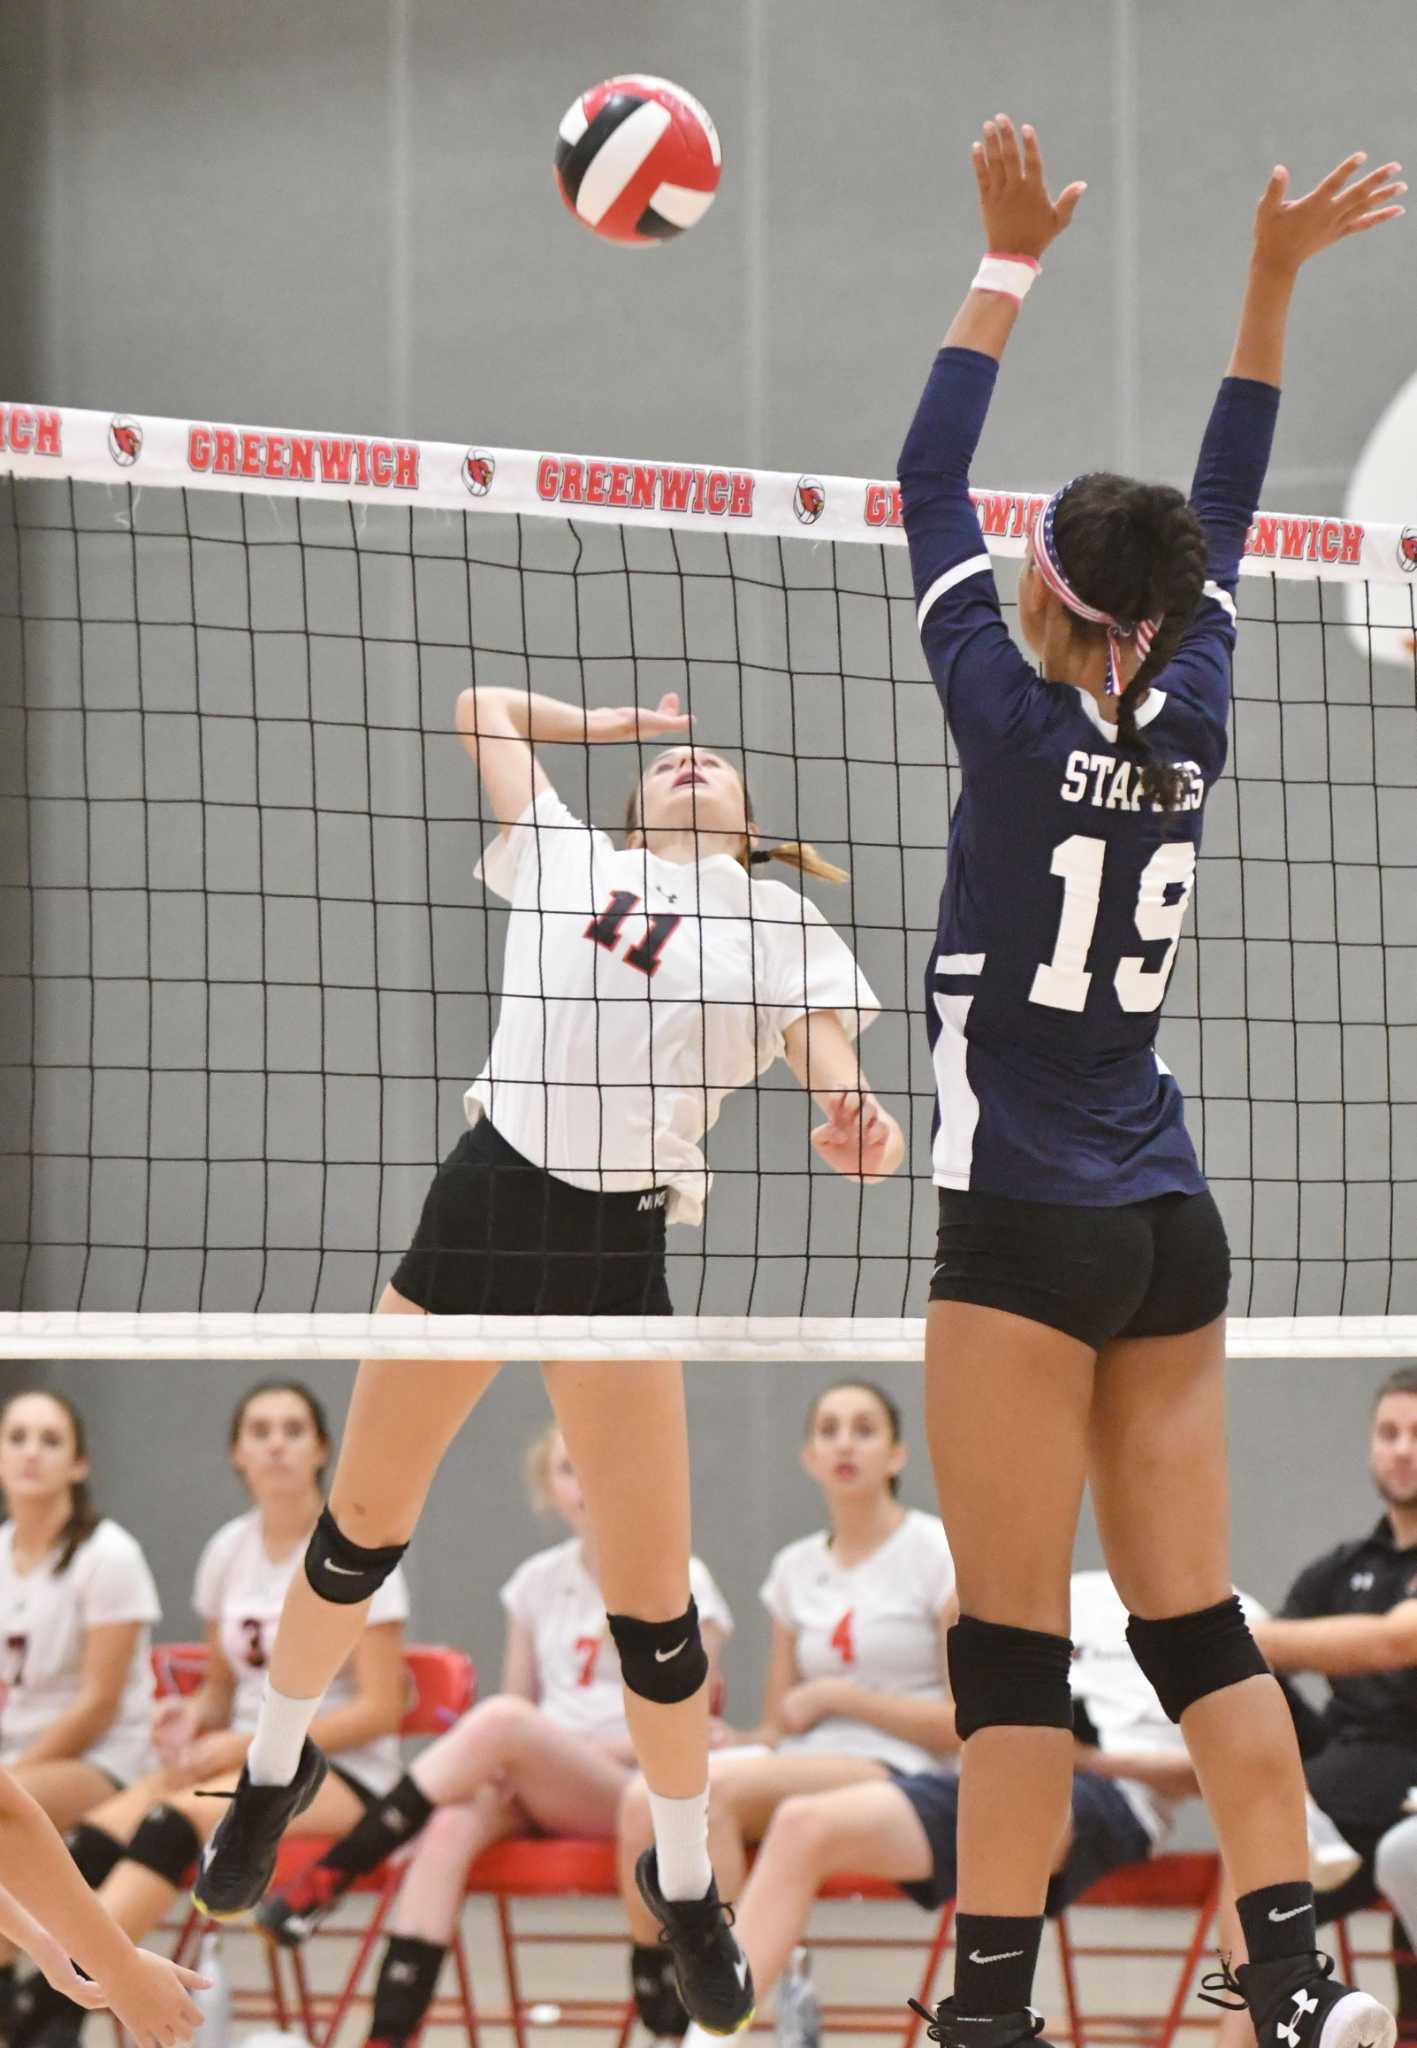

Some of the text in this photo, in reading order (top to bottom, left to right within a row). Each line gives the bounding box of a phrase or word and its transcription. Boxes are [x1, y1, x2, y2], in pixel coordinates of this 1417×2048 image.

[188, 424, 419, 489] GREENWICH
[537, 456, 754, 517] GREENWICH
[583, 890, 682, 976] 11
[1028, 834, 1196, 1013] 19
[575, 1636, 598, 1687] 7
[830, 1608, 855, 1664] 4
